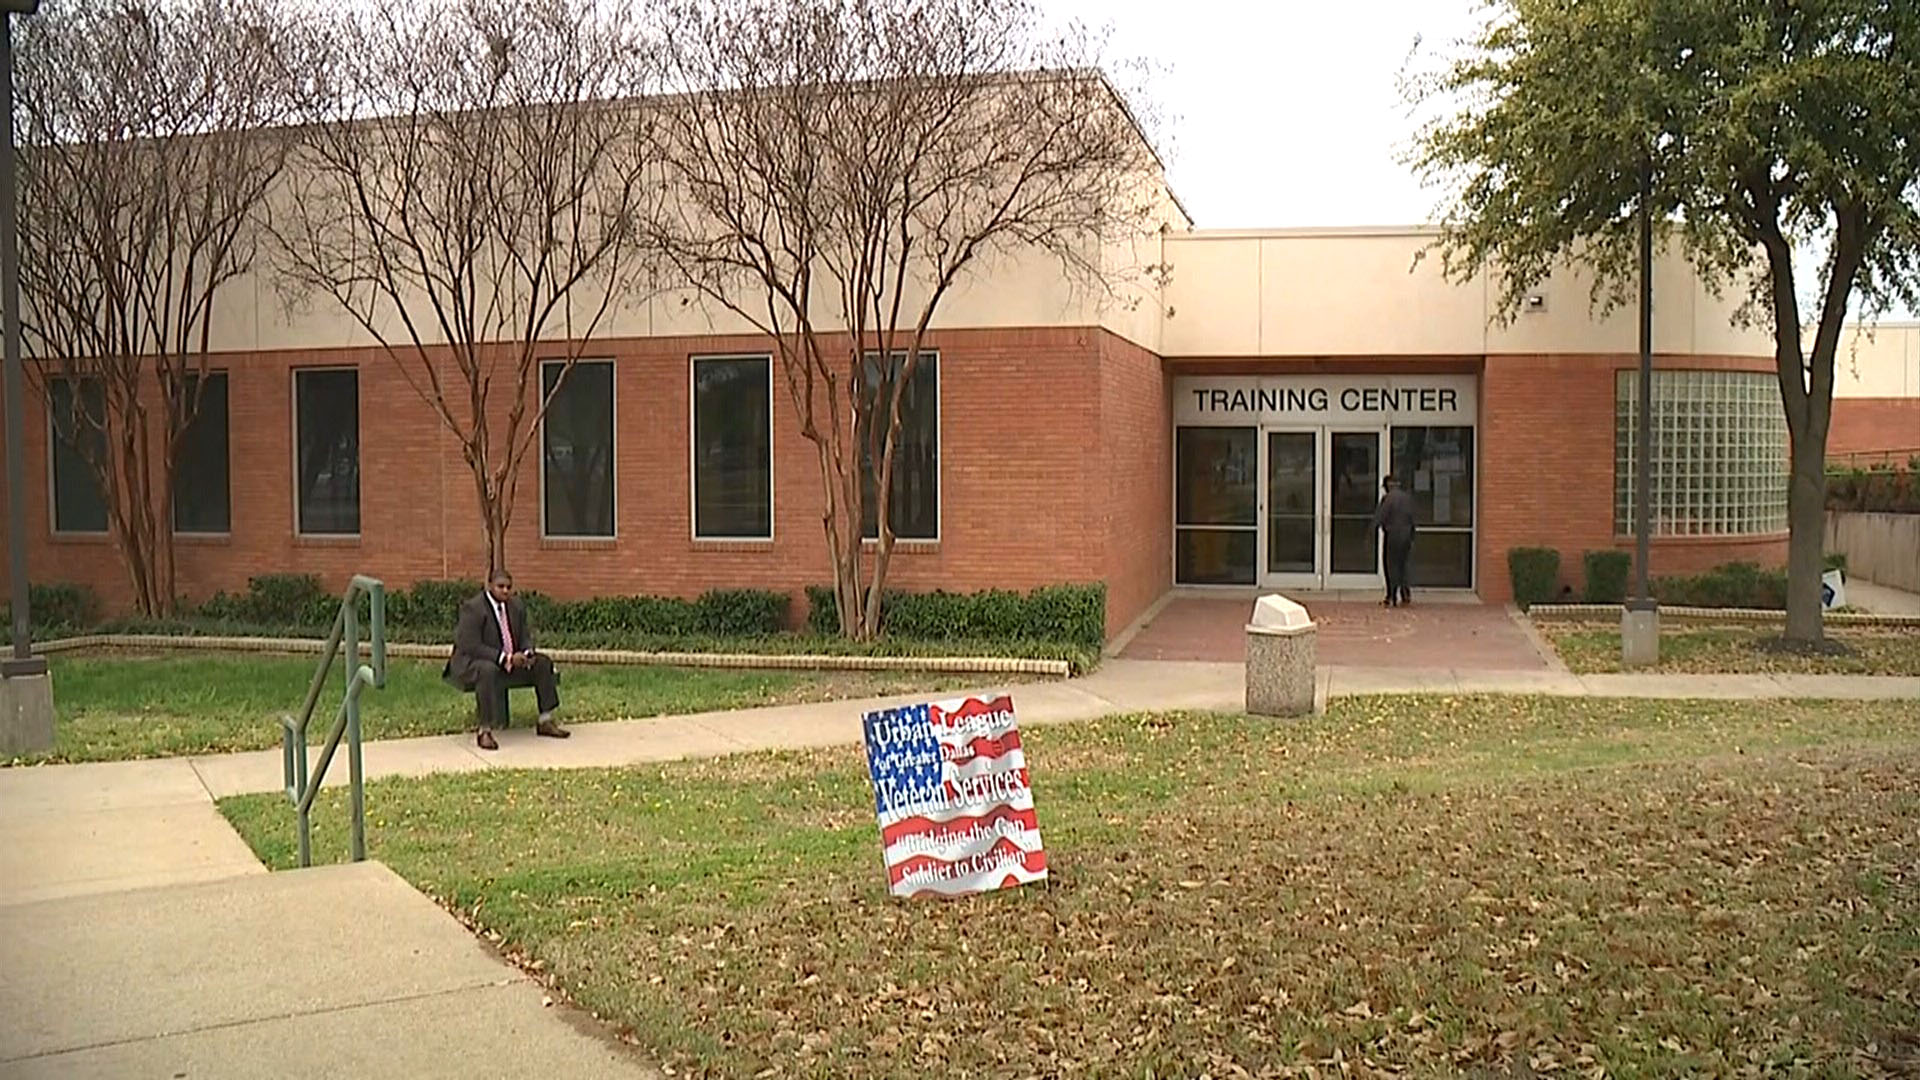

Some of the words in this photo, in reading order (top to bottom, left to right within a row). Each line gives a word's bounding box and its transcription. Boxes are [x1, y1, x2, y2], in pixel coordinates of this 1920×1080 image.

[1192, 388, 1328, 411] TRAINING
[1340, 388, 1457, 411] CENTER
[873, 718, 935, 746] Urban
[938, 709, 1011, 739] League
[878, 755, 891, 770] of
[939, 745, 975, 762] Dallas
[877, 777, 950, 823] Veteran
[950, 762, 1025, 808] Services
[969, 820, 992, 842] the
[994, 815, 1025, 839] Gap
[902, 861, 951, 887] Soldier
[954, 862, 969, 878] to
